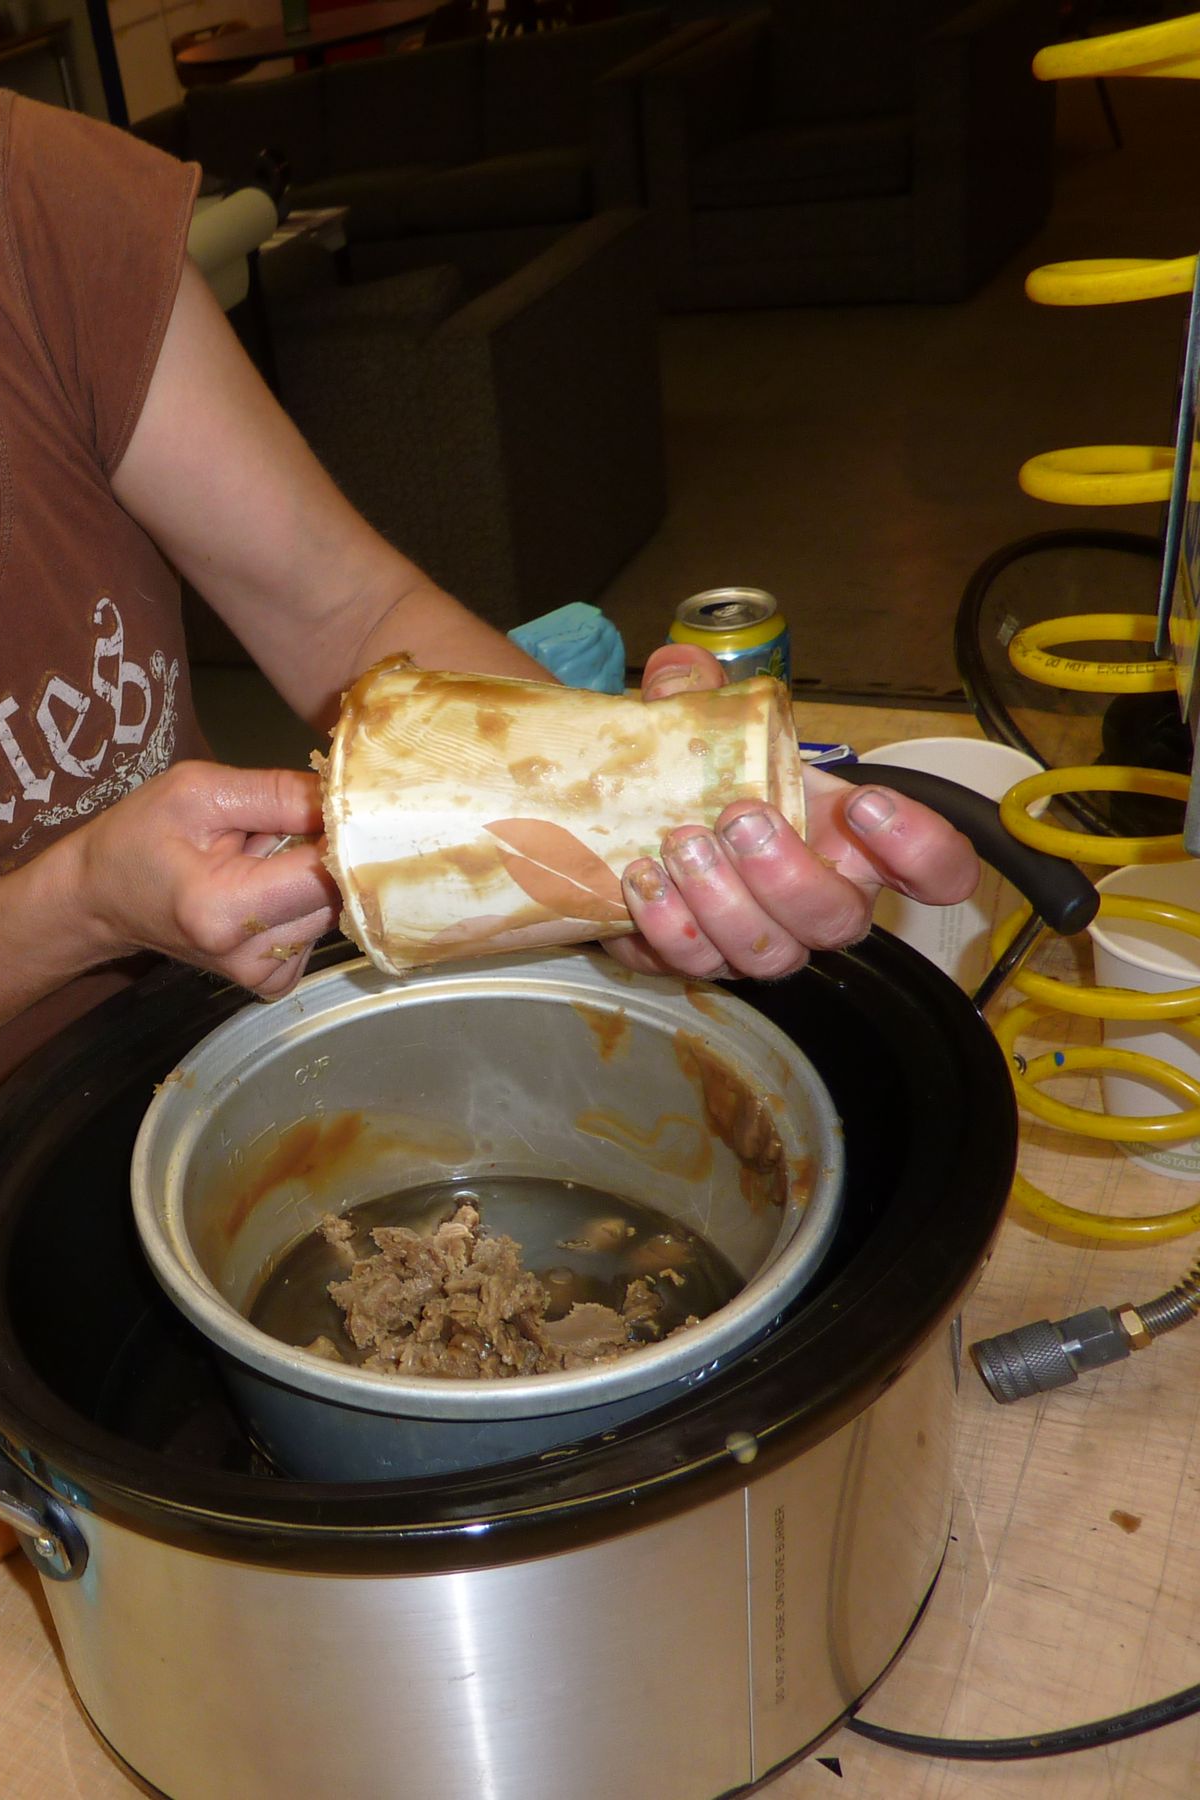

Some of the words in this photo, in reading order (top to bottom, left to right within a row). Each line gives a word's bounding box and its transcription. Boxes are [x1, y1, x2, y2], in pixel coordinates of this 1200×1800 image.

[1064, 662, 1089, 673] NOT
[1097, 664, 1157, 675] EXCEED
[774, 1505, 785, 1552] BURNER
[774, 1554, 785, 1591] STOVE
